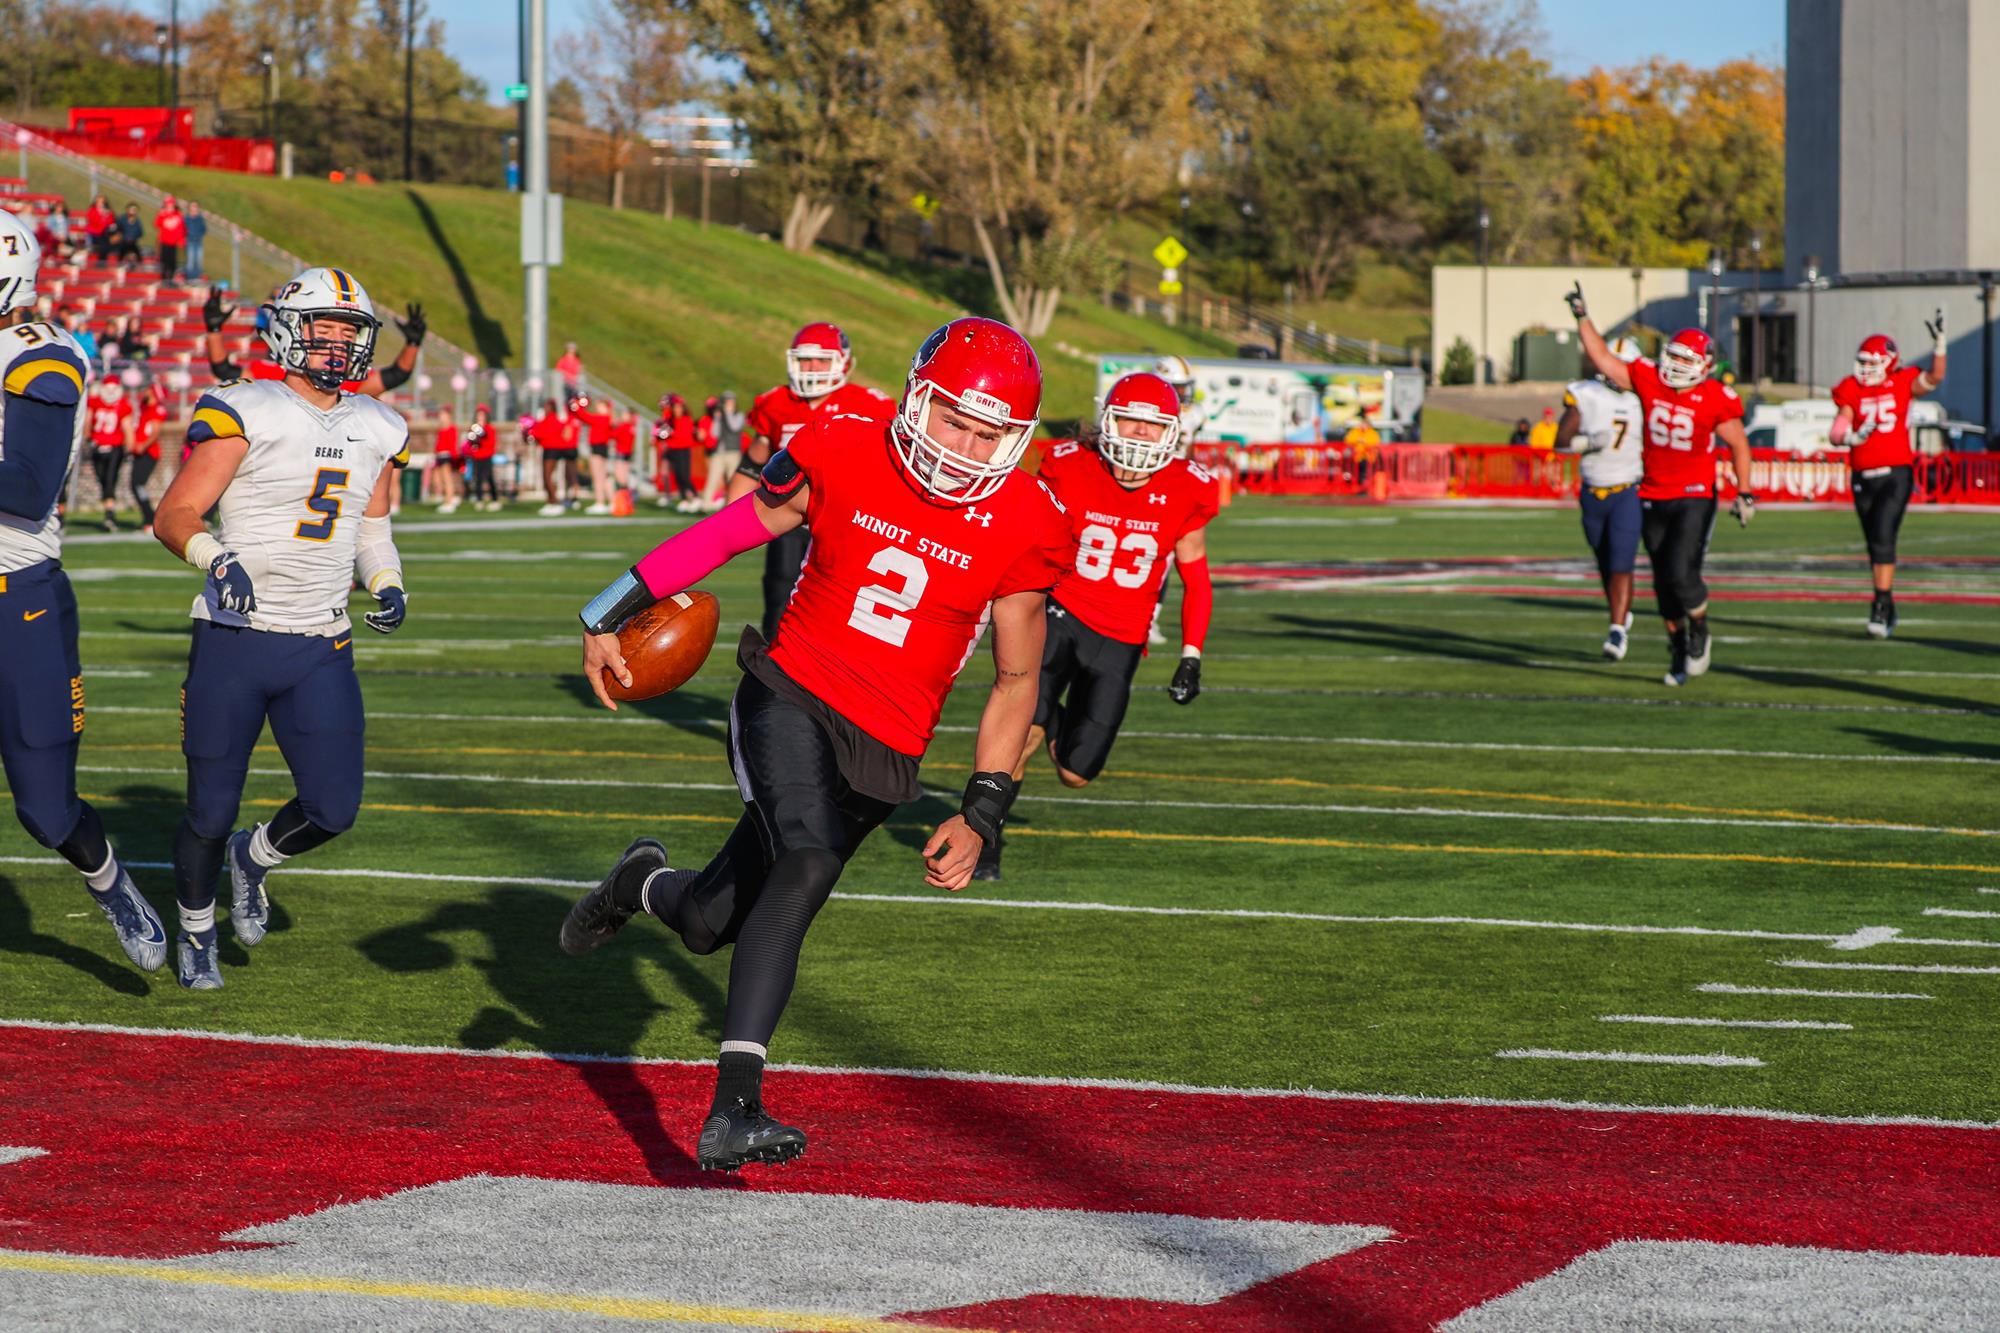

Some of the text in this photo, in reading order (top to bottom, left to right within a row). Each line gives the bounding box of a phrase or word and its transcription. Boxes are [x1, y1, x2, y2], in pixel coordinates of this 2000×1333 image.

[975, 394, 998, 410] GRIT
[1613, 418, 1628, 450] 7
[1648, 405, 1695, 452] 62
[315, 446, 344, 459] BEARS
[294, 467, 350, 542] 5
[1084, 510, 1161, 532] MINOT STATE
[851, 509, 973, 571] MINOT STATE
[1074, 523, 1160, 589] 83
[847, 545, 930, 648] 2
